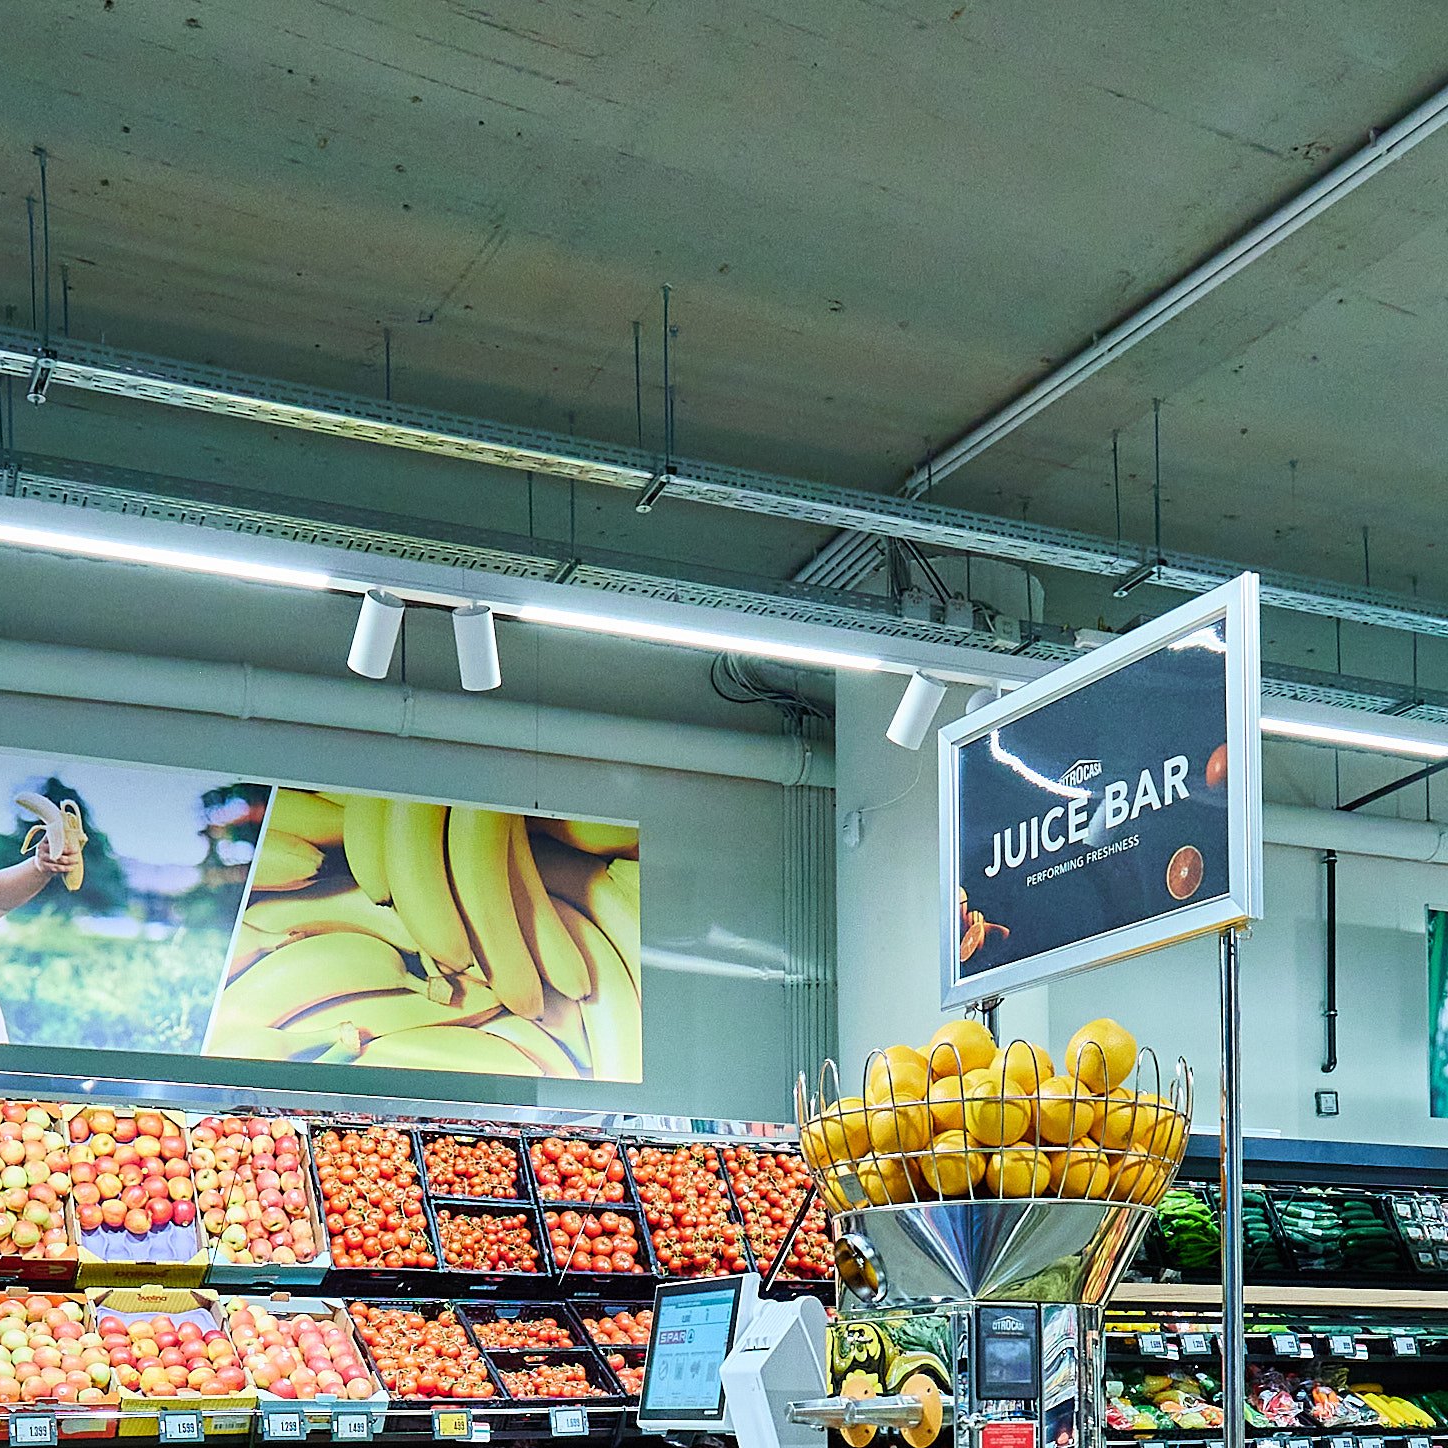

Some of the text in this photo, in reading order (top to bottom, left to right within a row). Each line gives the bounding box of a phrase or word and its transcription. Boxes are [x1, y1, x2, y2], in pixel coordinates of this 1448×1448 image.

[984, 755, 1190, 878] JUICE BAR
[1026, 834, 1140, 887] PERFORMING FRESHNESS
[660, 1331, 686, 1344] SPAR
[29, 1423, 48, 1436] 1.399
[177, 1422, 196, 1434] 1.599
[280, 1421, 297, 1432] 1.299
[349, 1421, 365, 1432] 1.499
